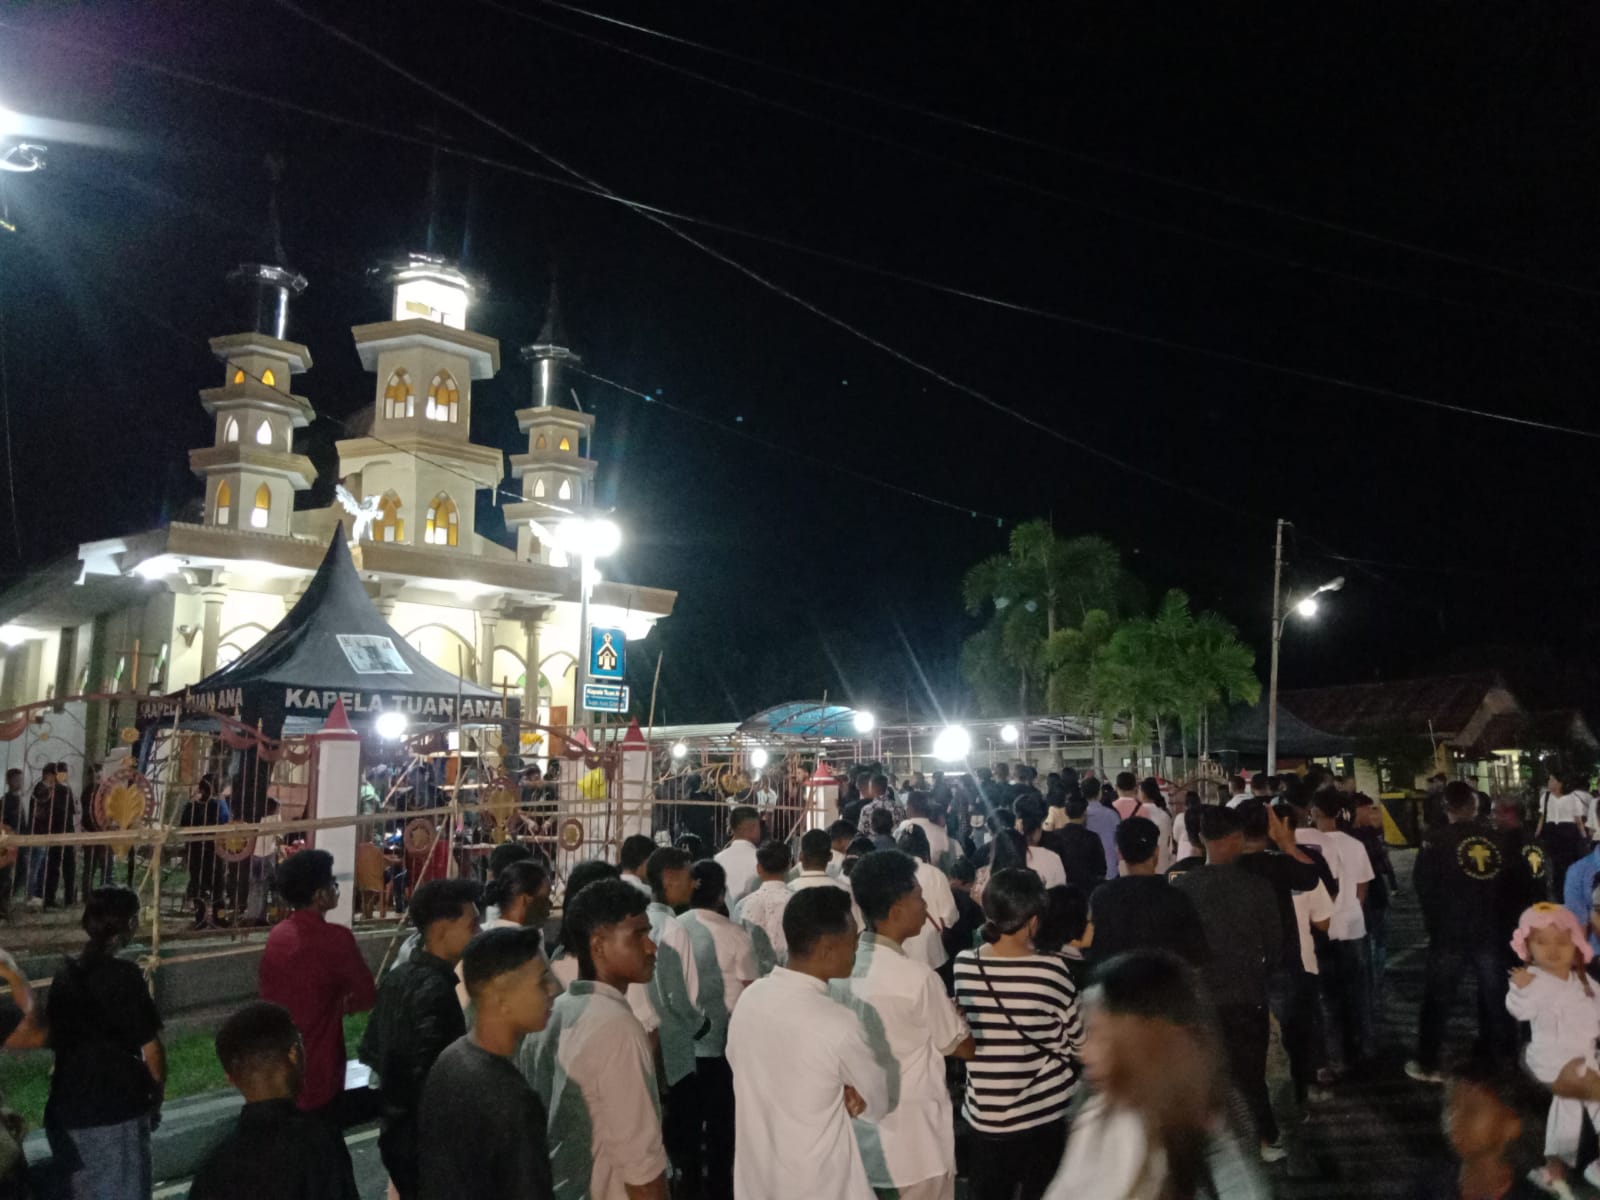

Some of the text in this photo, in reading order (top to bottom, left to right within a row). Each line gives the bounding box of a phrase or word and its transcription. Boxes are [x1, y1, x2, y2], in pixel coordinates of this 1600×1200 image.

[184, 691, 216, 712] UAN
[217, 687, 244, 710] ANA
[284, 688, 504, 719] KAPELA TUAN ANA
